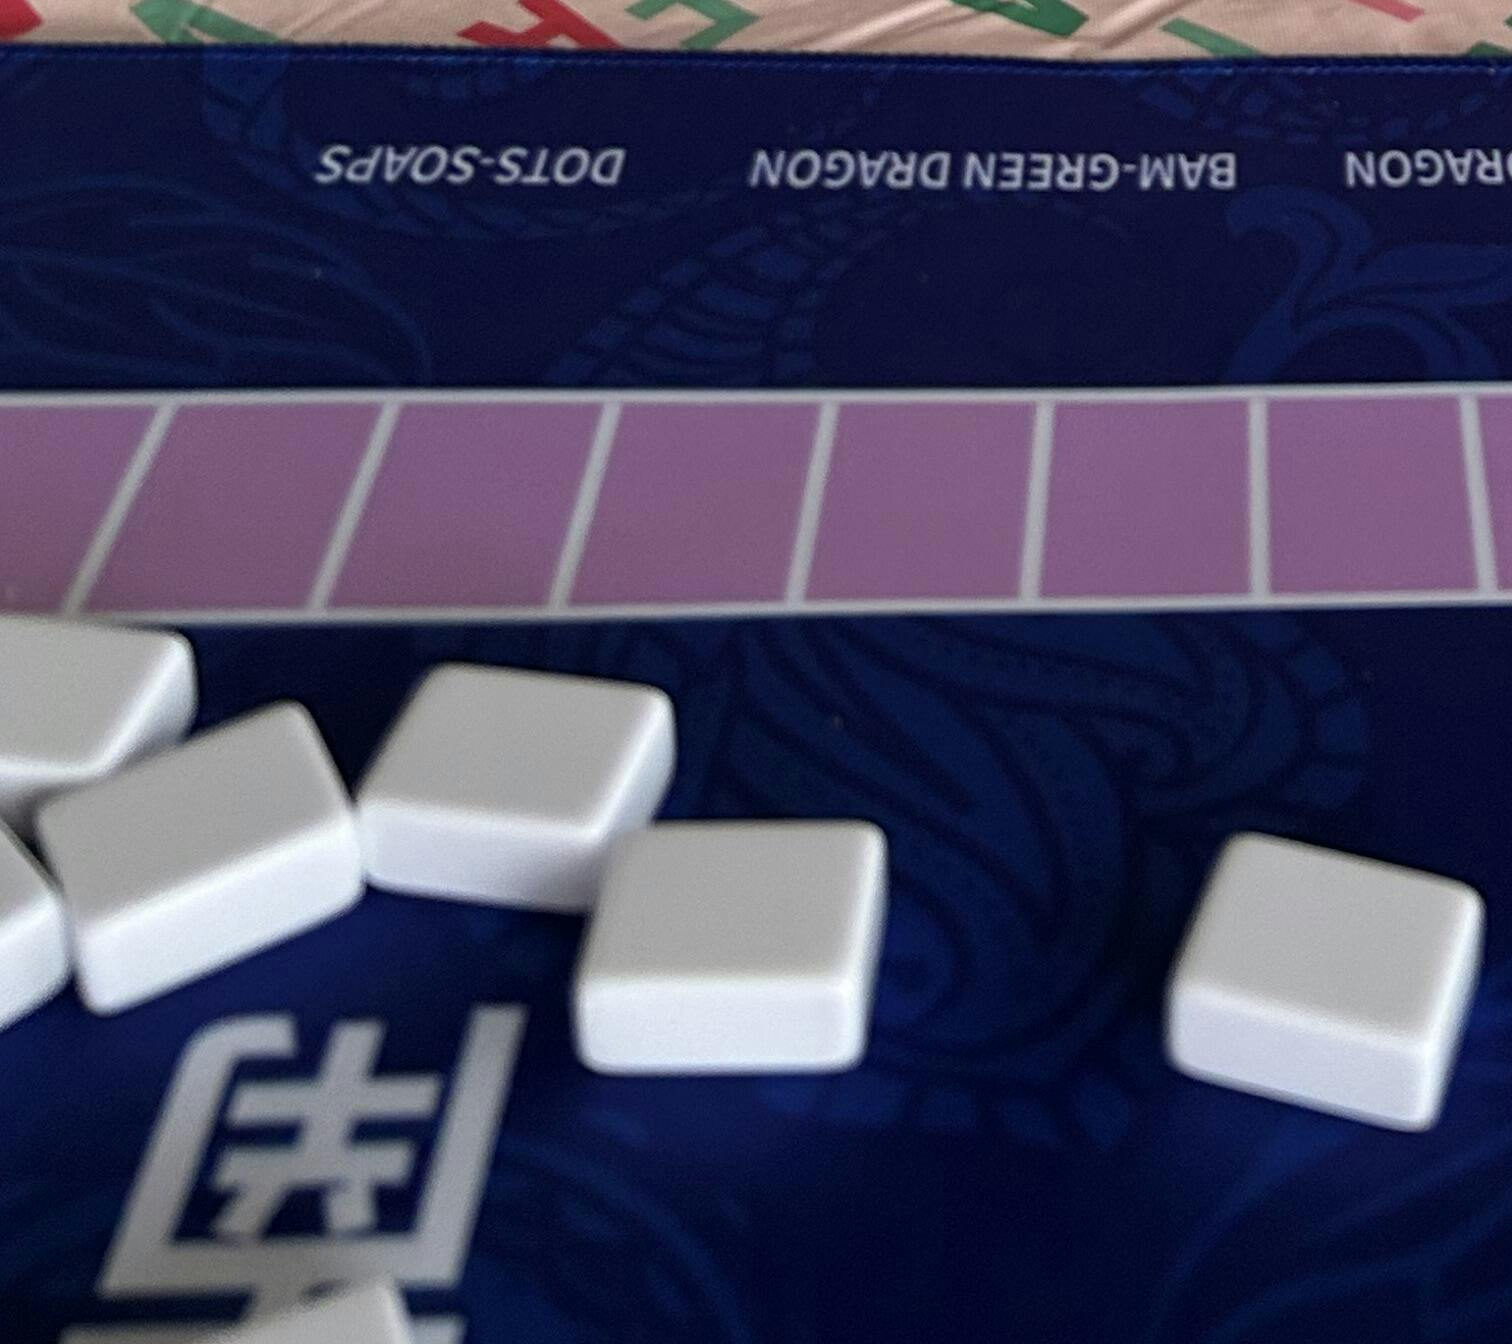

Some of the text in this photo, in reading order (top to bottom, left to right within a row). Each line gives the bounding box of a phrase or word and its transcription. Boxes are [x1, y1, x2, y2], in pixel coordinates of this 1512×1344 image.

[314, 144, 626, 187] DOTS-SOAPS
[749, 148, 1238, 192] BAM-GREEN DRAGON
